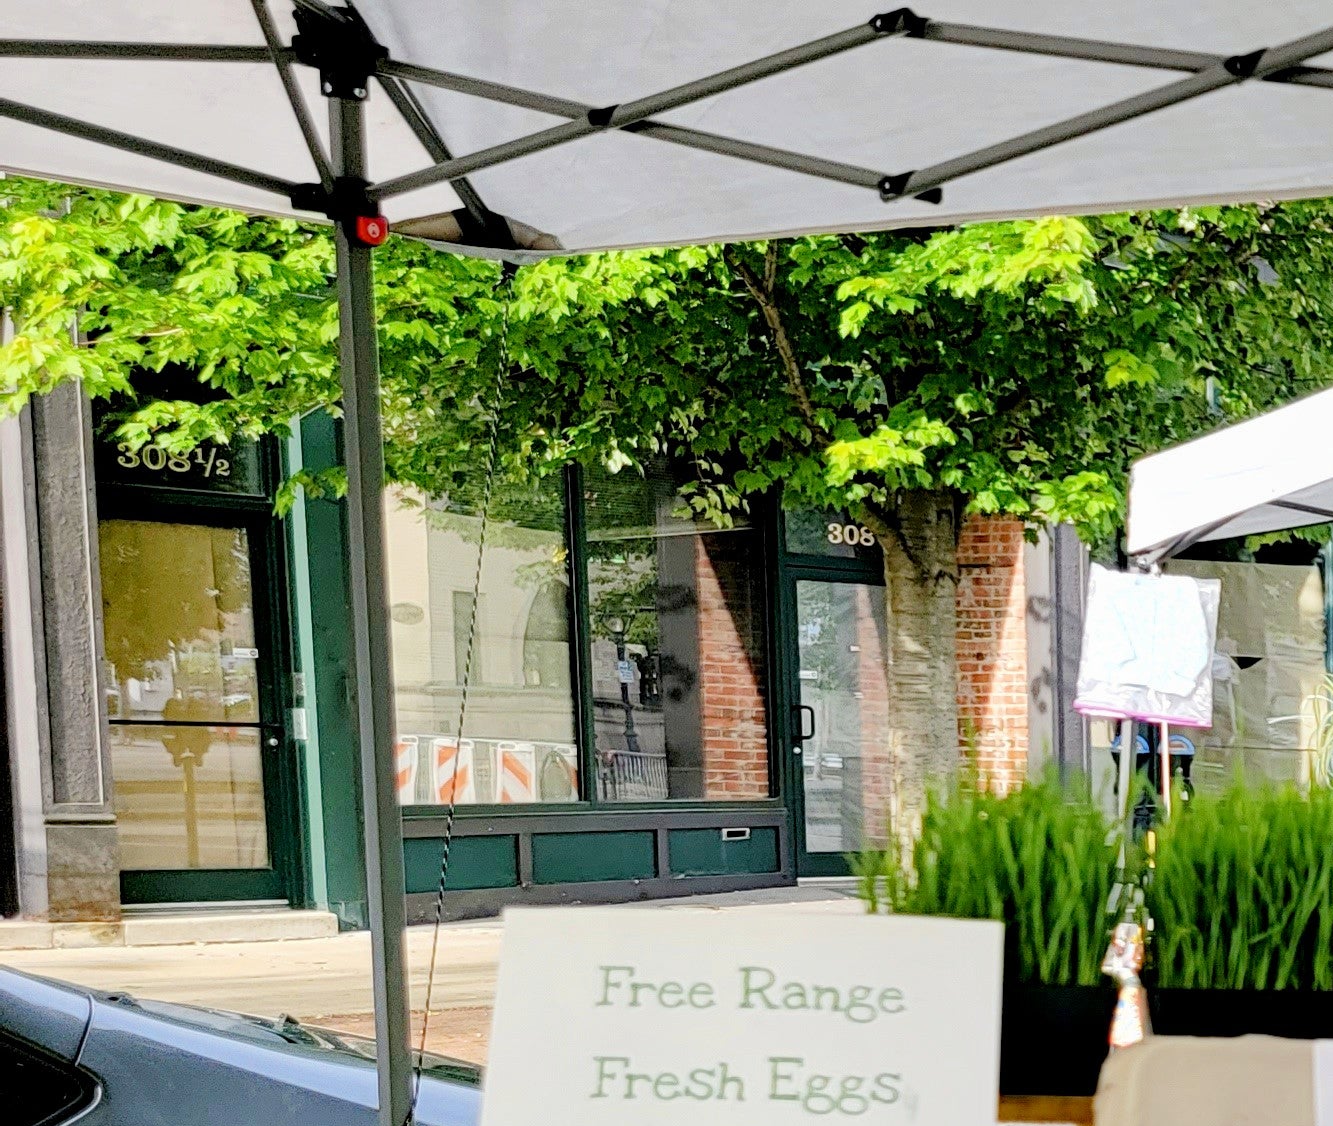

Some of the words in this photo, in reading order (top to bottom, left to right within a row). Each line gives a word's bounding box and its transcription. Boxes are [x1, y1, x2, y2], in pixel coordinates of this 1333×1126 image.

[828, 523, 875, 546] 308
[595, 965, 715, 1009] Free
[738, 966, 906, 1024] Range
[589, 1056, 745, 1102] Fresh
[767, 1056, 901, 1115] Eggs
